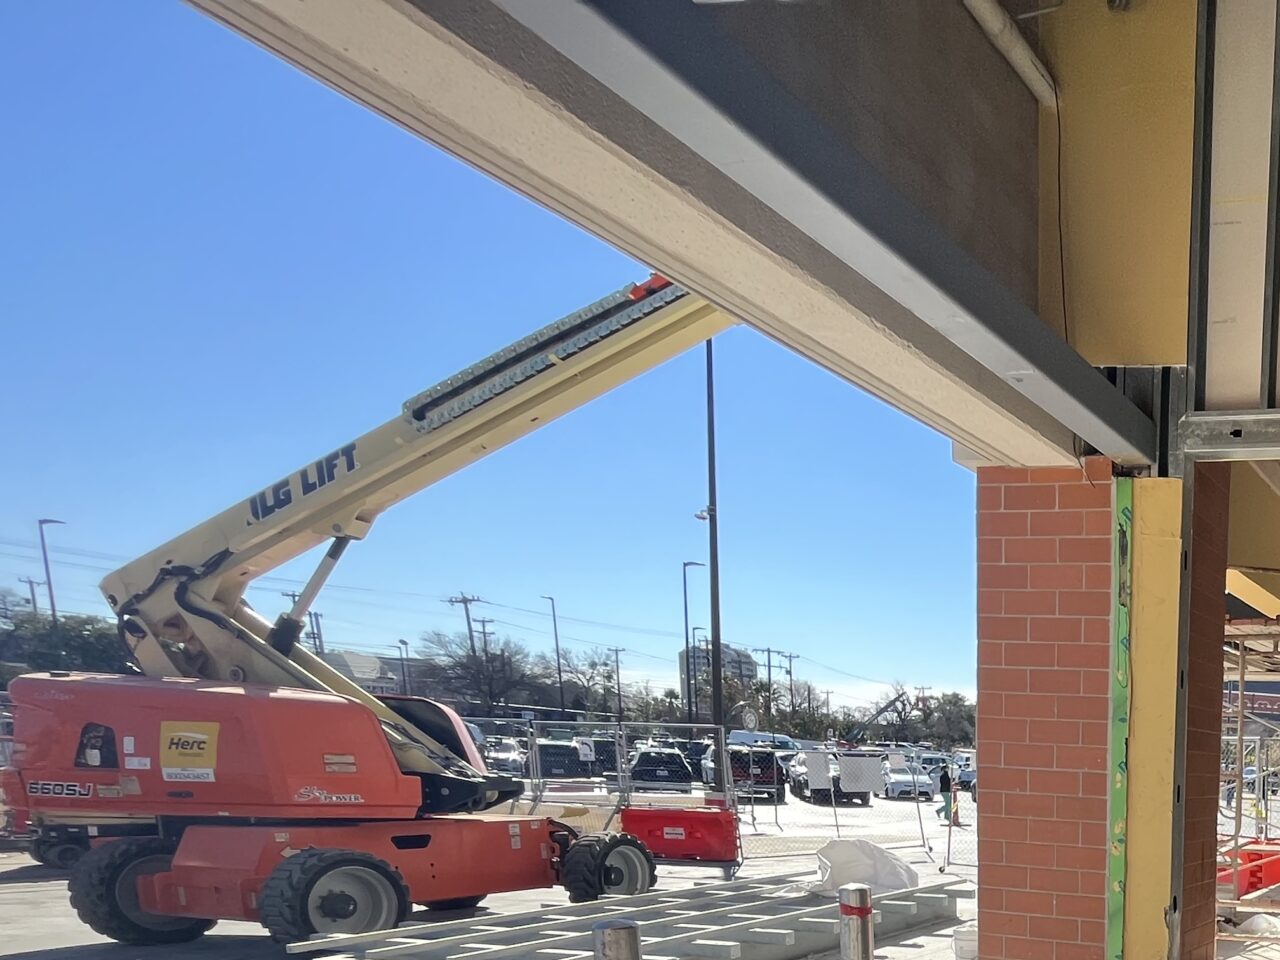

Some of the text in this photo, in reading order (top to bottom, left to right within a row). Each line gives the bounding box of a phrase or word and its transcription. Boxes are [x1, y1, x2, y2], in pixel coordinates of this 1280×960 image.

[246, 442, 357, 526] JLG LIFT
[168, 737, 207, 751] Herc
